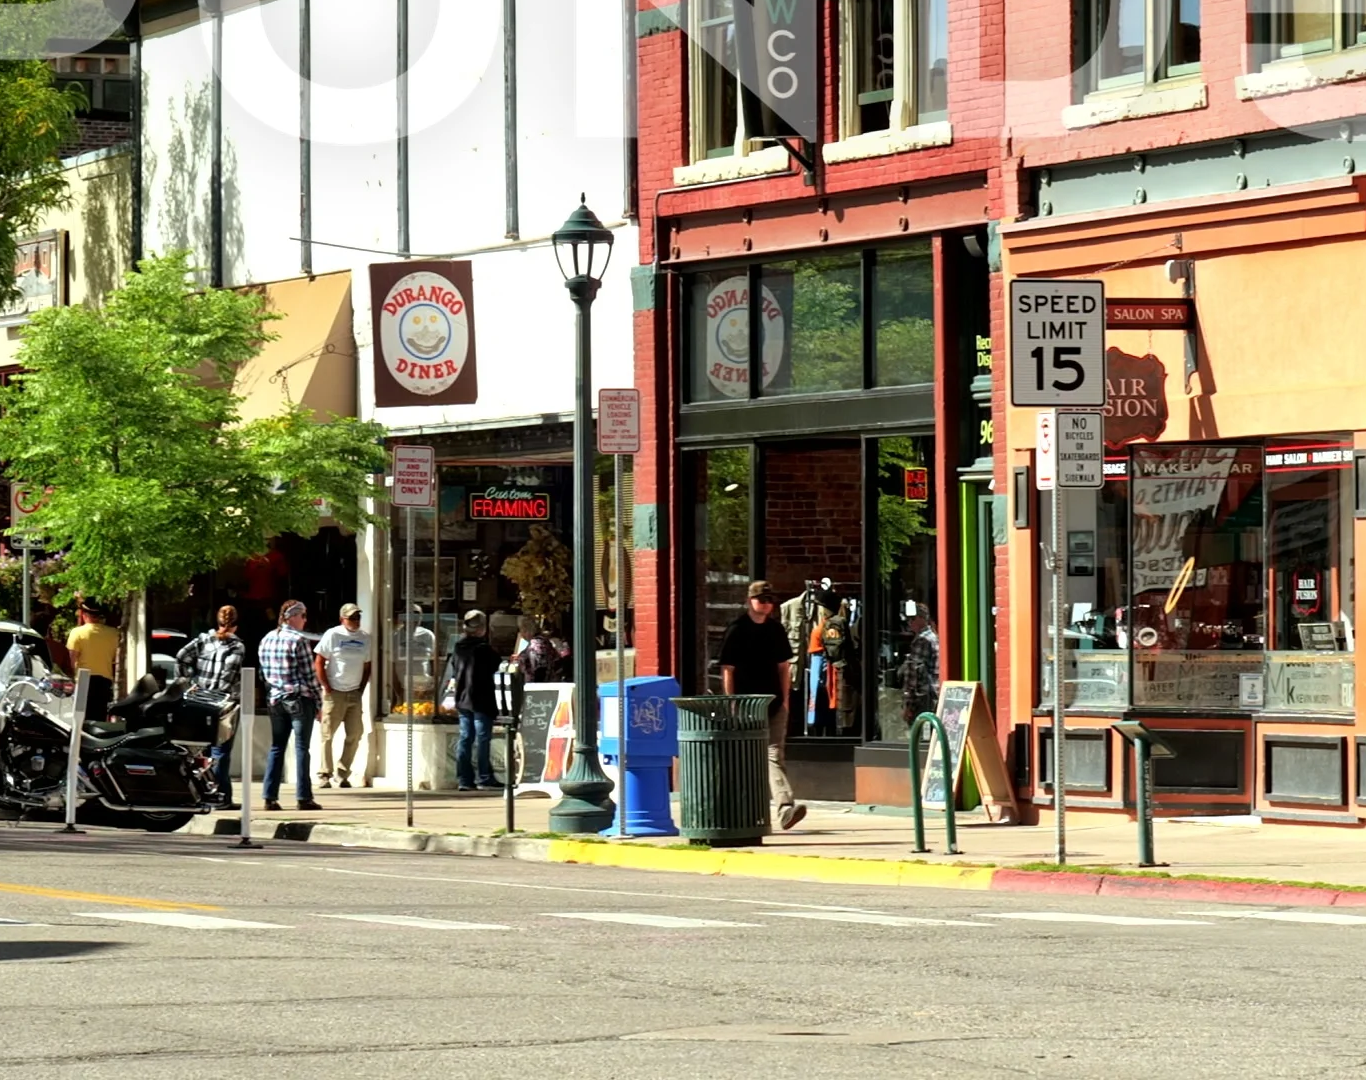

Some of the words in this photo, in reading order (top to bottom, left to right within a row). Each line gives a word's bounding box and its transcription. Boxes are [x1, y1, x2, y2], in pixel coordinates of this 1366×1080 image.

[383, 285, 463, 316] DURANGO
[1019, 295, 1096, 314] SPEED
[1114, 309, 1154, 320] SALON
[1161, 309, 1184, 319] SPA
[1027, 321, 1087, 340] LIMIT
[976, 335, 992, 350] Rec
[395, 358, 458, 379] DINER
[1031, 347, 1085, 391] 15
[1104, 378, 1147, 396] AIR
[1103, 399, 1158, 417] SION
[1072, 418, 1087, 430] NO
[980, 420, 993, 445] 96
[1065, 432, 1094, 440] BICYCLES
[1076, 442, 1084, 450] OR
[1060, 453, 1100, 461] SKATEBOARDS
[1266, 454, 1283, 465] HAIR
[1284, 452, 1307, 464] SALON
[1312, 450, 1340, 462] BARBER
[1343, 450, 1354, 461] SH
[1103, 464, 1126, 475] SSAGE
[1144, 463, 1198, 474] MAKEU
[1231, 463, 1253, 473] AR
[1065, 474, 1095, 482] SIDEWALK
[485, 486, 533, 500] Custom
[473, 499, 546, 518] FRAMING
[1298, 579, 1315, 589] HAIR
